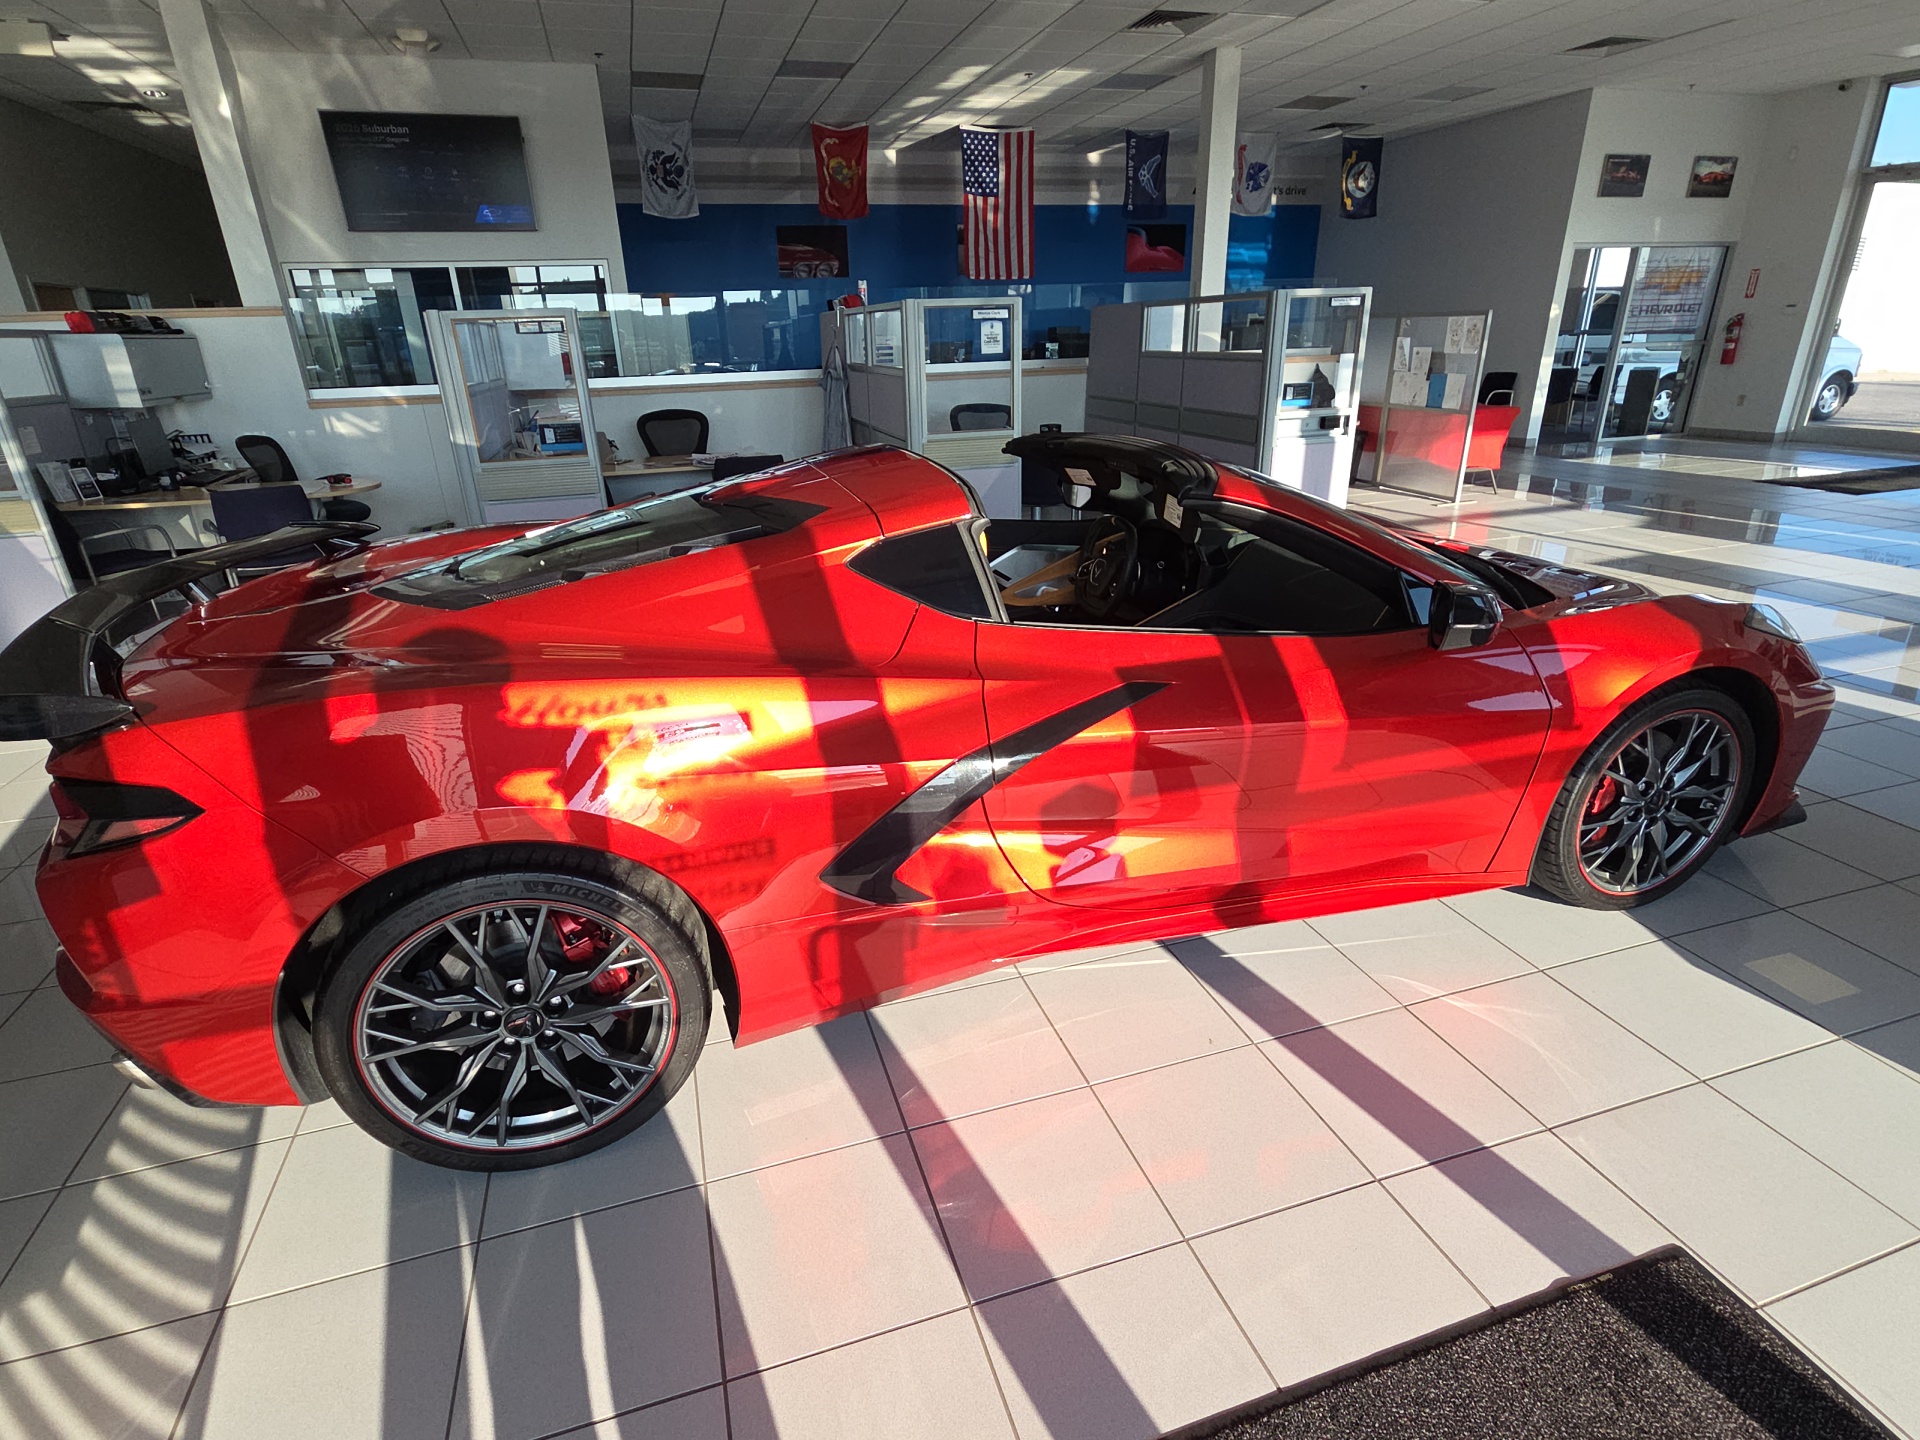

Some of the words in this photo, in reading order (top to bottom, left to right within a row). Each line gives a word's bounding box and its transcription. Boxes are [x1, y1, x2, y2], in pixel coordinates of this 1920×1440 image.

[361, 124, 410, 134] Suburban
[1127, 160, 1135, 177] AIR
[1285, 186, 1307, 195] drive
[1630, 303, 1703, 315] CHEVROLET
[551, 884, 640, 920] MICHELIN
